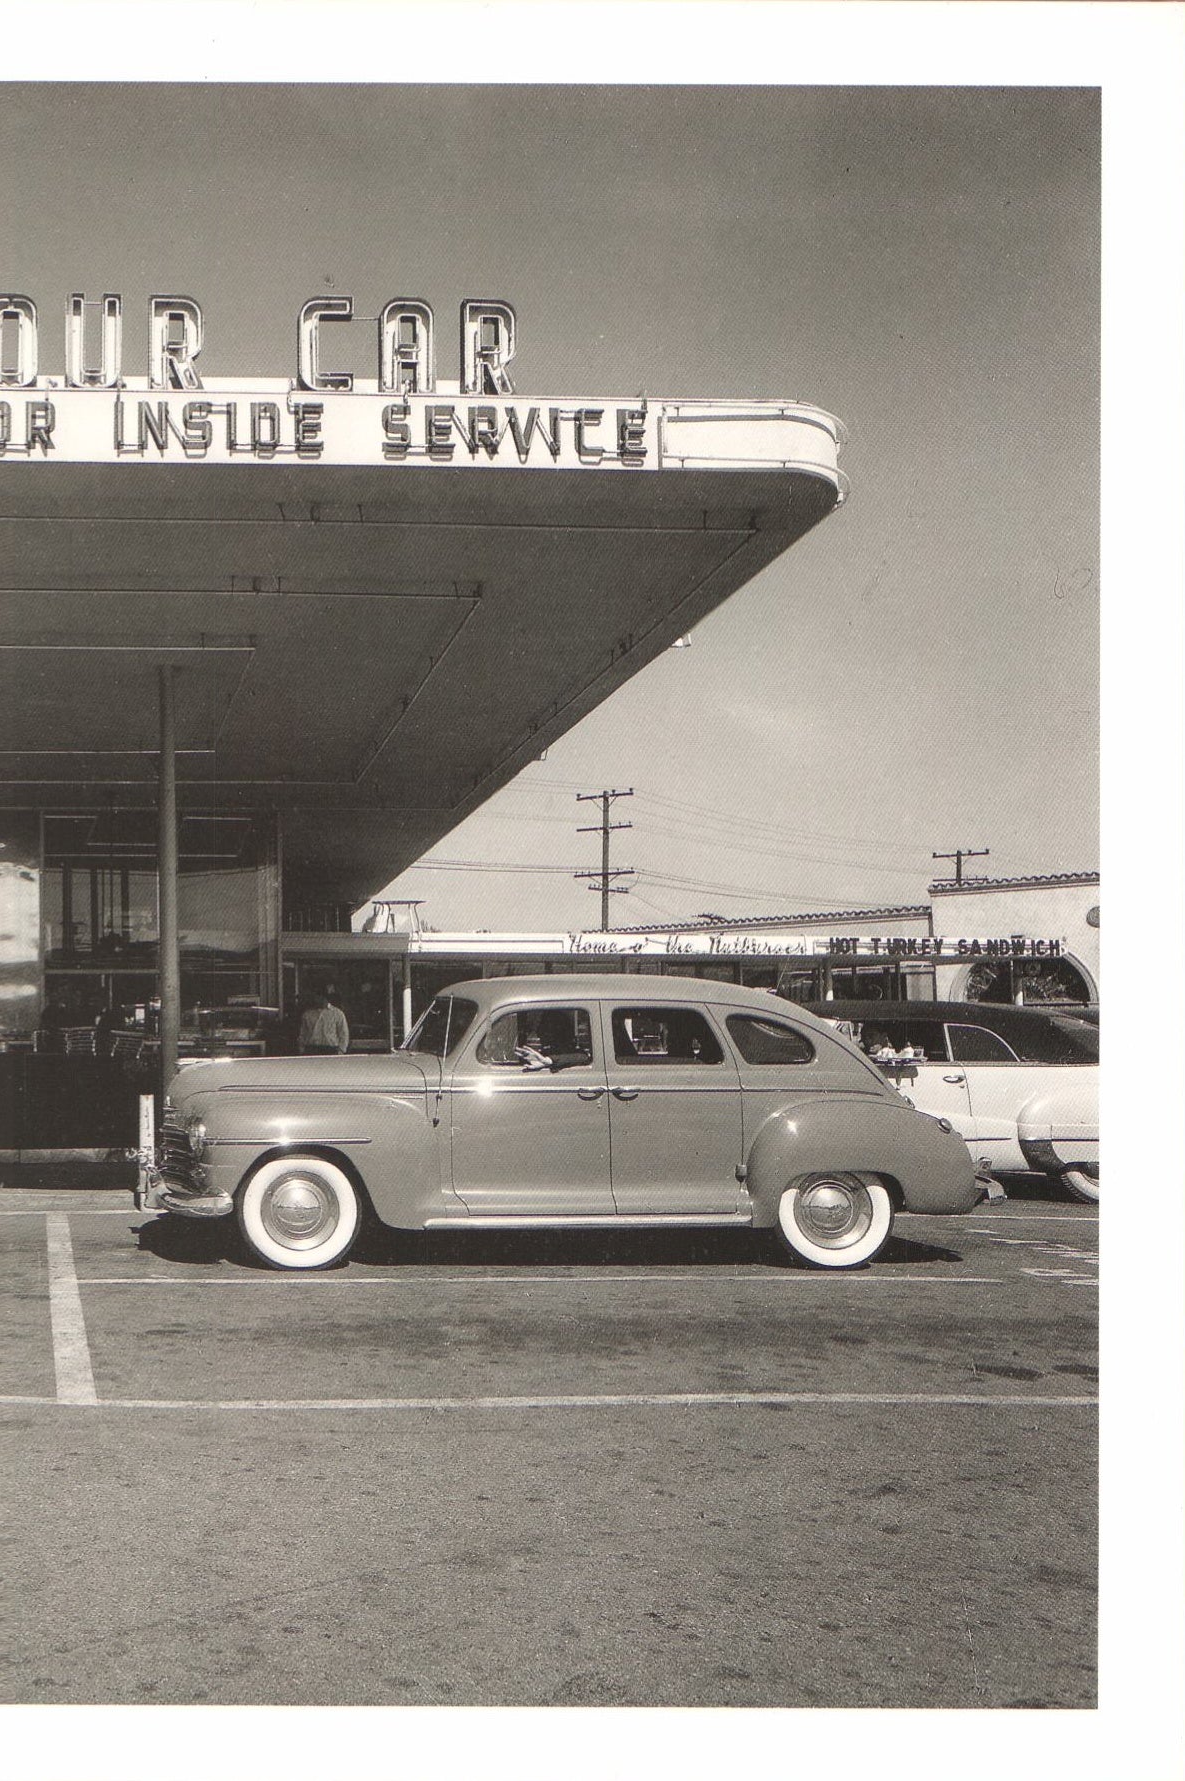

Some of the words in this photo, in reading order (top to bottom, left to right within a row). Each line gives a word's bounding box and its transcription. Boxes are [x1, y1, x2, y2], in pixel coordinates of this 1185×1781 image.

[297, 295, 518, 396] CAR
[115, 400, 325, 458] INSIDE
[381, 402, 649, 466] SERVICE
[569, 931, 617, 954] Home
[663, 934, 696, 954] the
[829, 936, 860, 956] HOT
[870, 936, 944, 957] TURKEY
[957, 937, 1061, 957] SANDWICH
